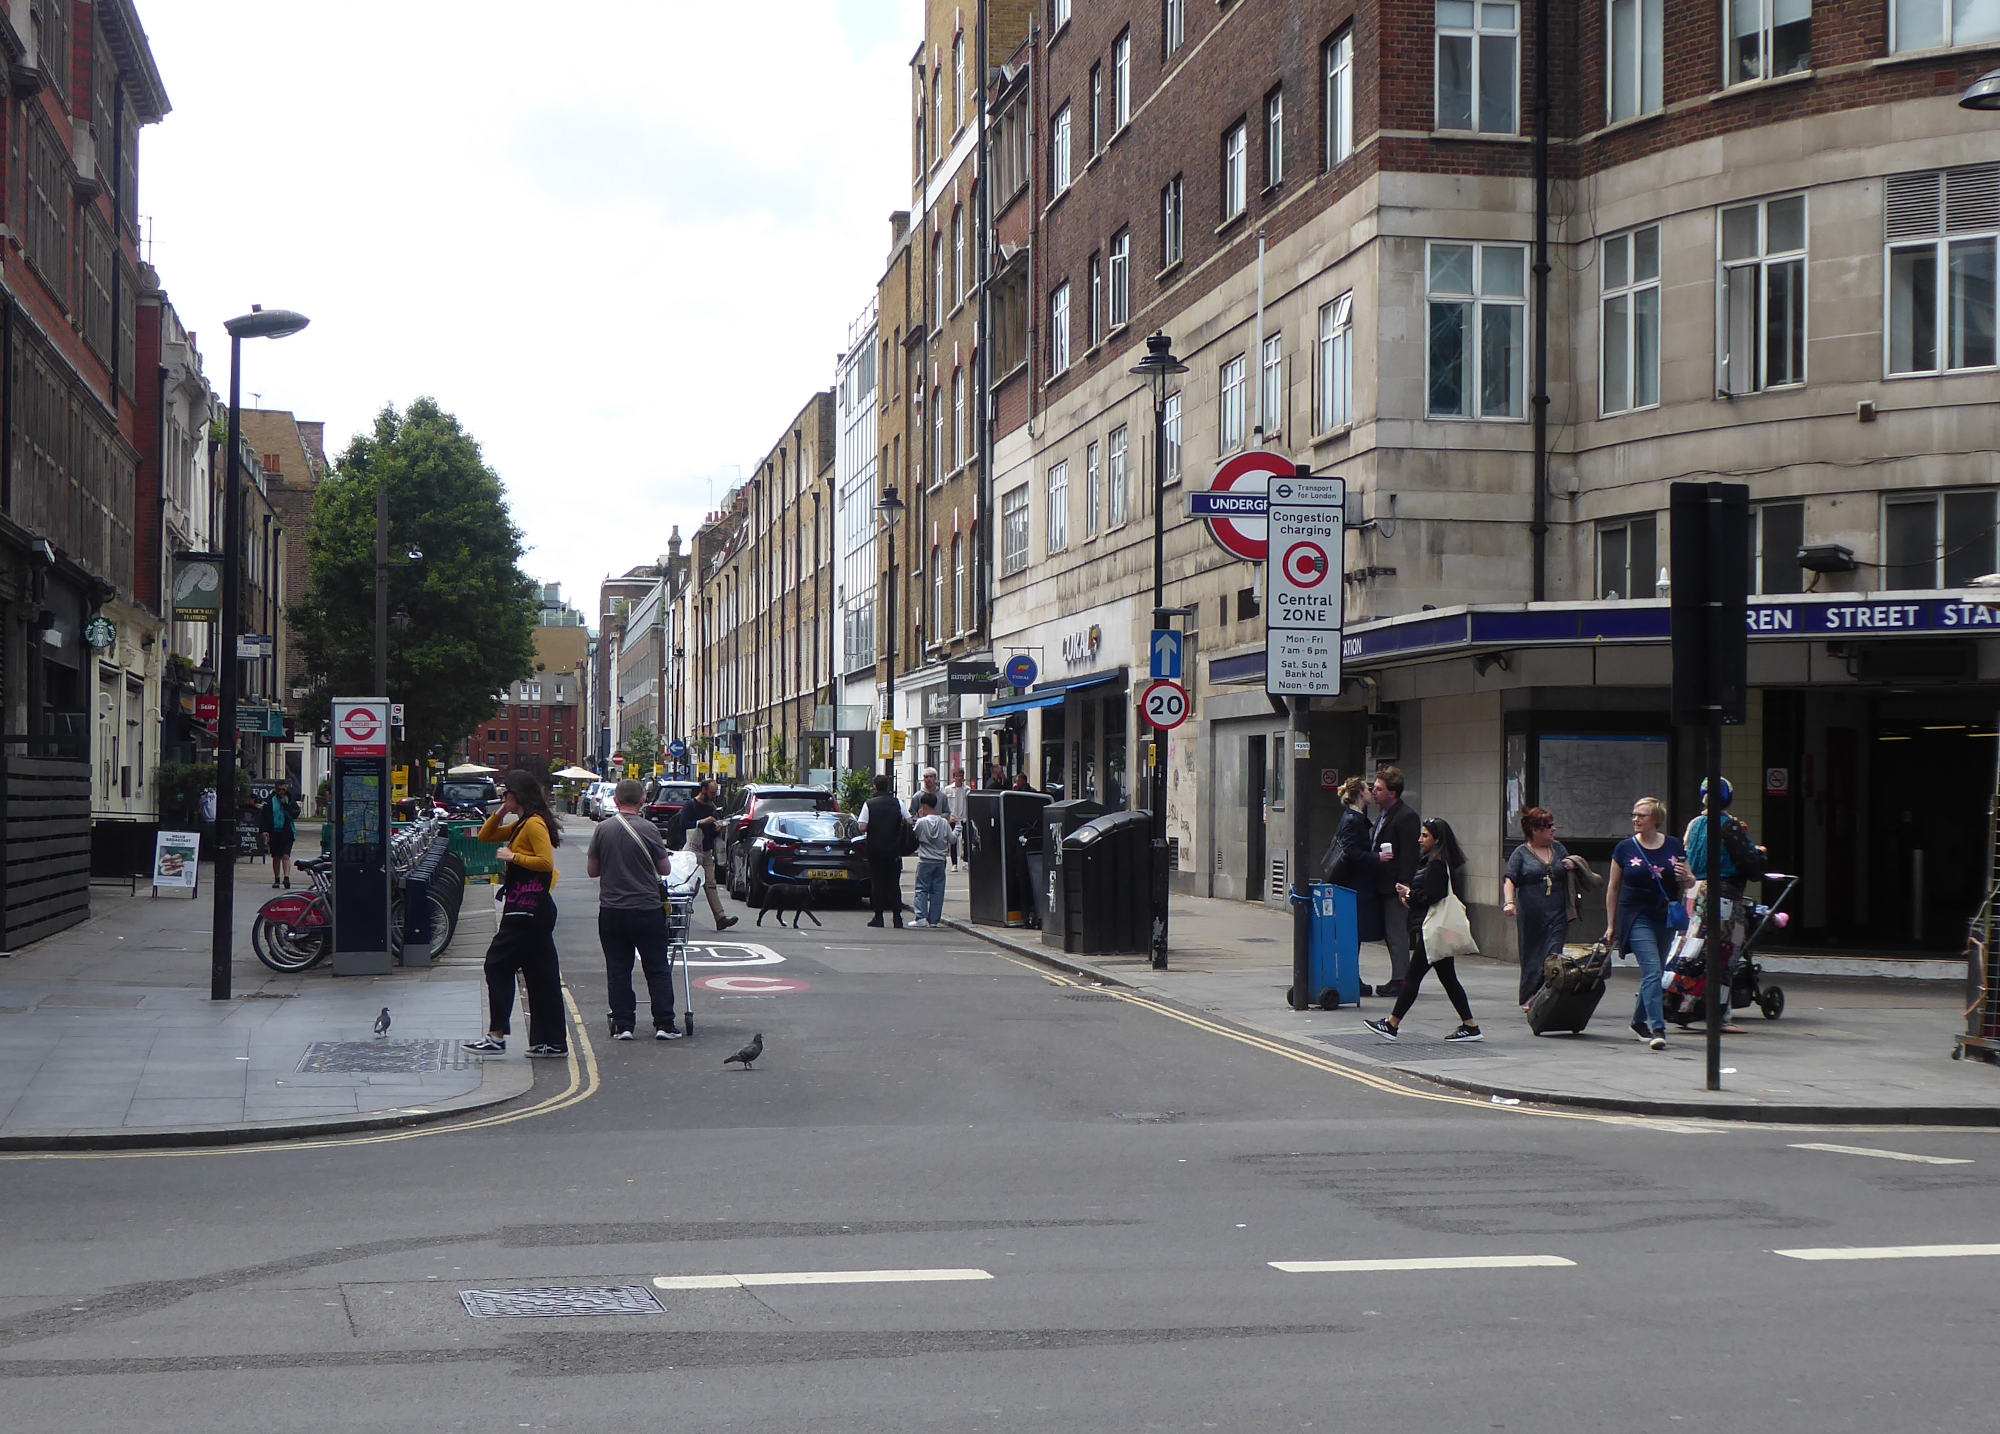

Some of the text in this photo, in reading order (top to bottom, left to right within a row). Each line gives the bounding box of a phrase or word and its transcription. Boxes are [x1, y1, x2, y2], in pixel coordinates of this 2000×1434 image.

[1297, 484, 1333, 492] Transport
[1273, 511, 1339, 524] Congestion
[1280, 525, 1331, 537] charging
[1278, 593, 1333, 606] Central
[1283, 609, 1327, 622] ZONE
[1826, 605, 1920, 628] STREET
[1286, 635, 1305, 643] Mon
[1311, 635, 1324, 643] Fri
[1342, 637, 1362, 657] ATION
[1301, 661, 1319, 669] Sun
[1321, 661, 1328, 669] &
[1285, 670, 1324, 678] Bank hol
[1278, 681, 1302, 689] Noon
[1315, 683, 1329, 691] pm
[1150, 695, 1183, 715] 20
